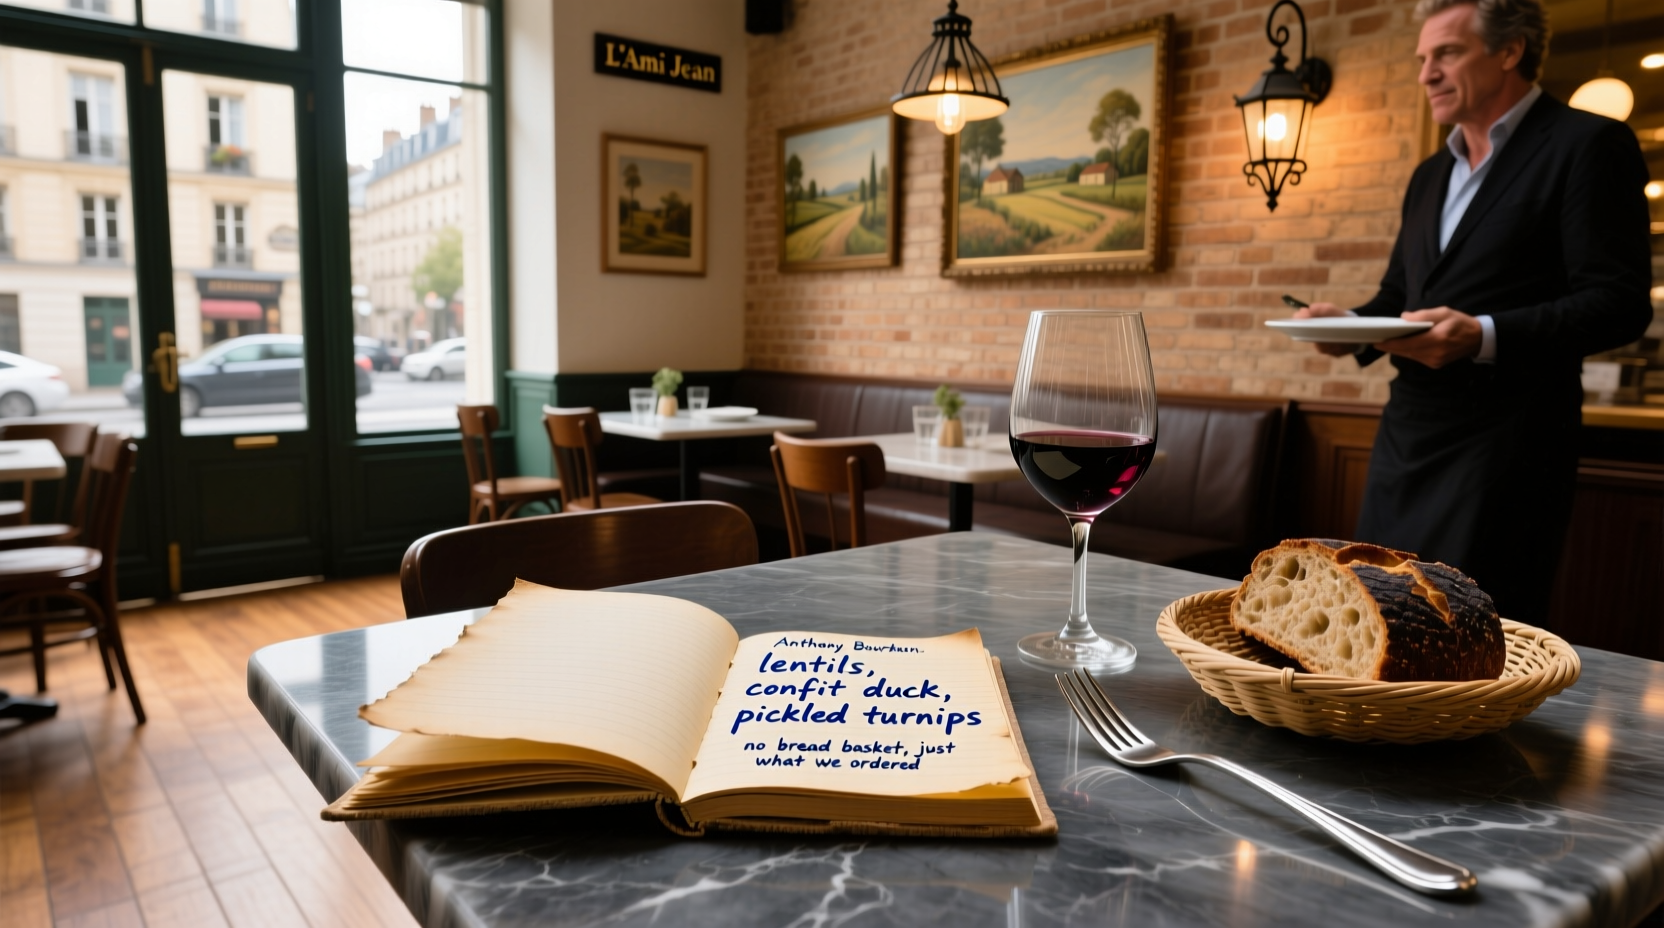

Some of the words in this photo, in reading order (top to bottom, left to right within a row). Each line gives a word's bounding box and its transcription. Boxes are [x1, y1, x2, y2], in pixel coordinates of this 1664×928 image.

[604, 43, 666, 75] L'Ami
[669, 55, 715, 82] Jean
[773, 637, 844, 653] Anthony
[759, 652, 874, 677] lentils,
[745, 677, 847, 702] confit
[862, 677, 952, 703] duck,
[730, 702, 850, 735] pickled
[862, 705, 983, 736] turnips
[743, 741, 766, 752] no
[777, 737, 832, 753] bread
[841, 739, 909, 757] basket,
[913, 741, 957, 758] just
[755, 753, 805, 768] what
[815, 757, 842, 769] we
[850, 757, 922, 771] ordered
